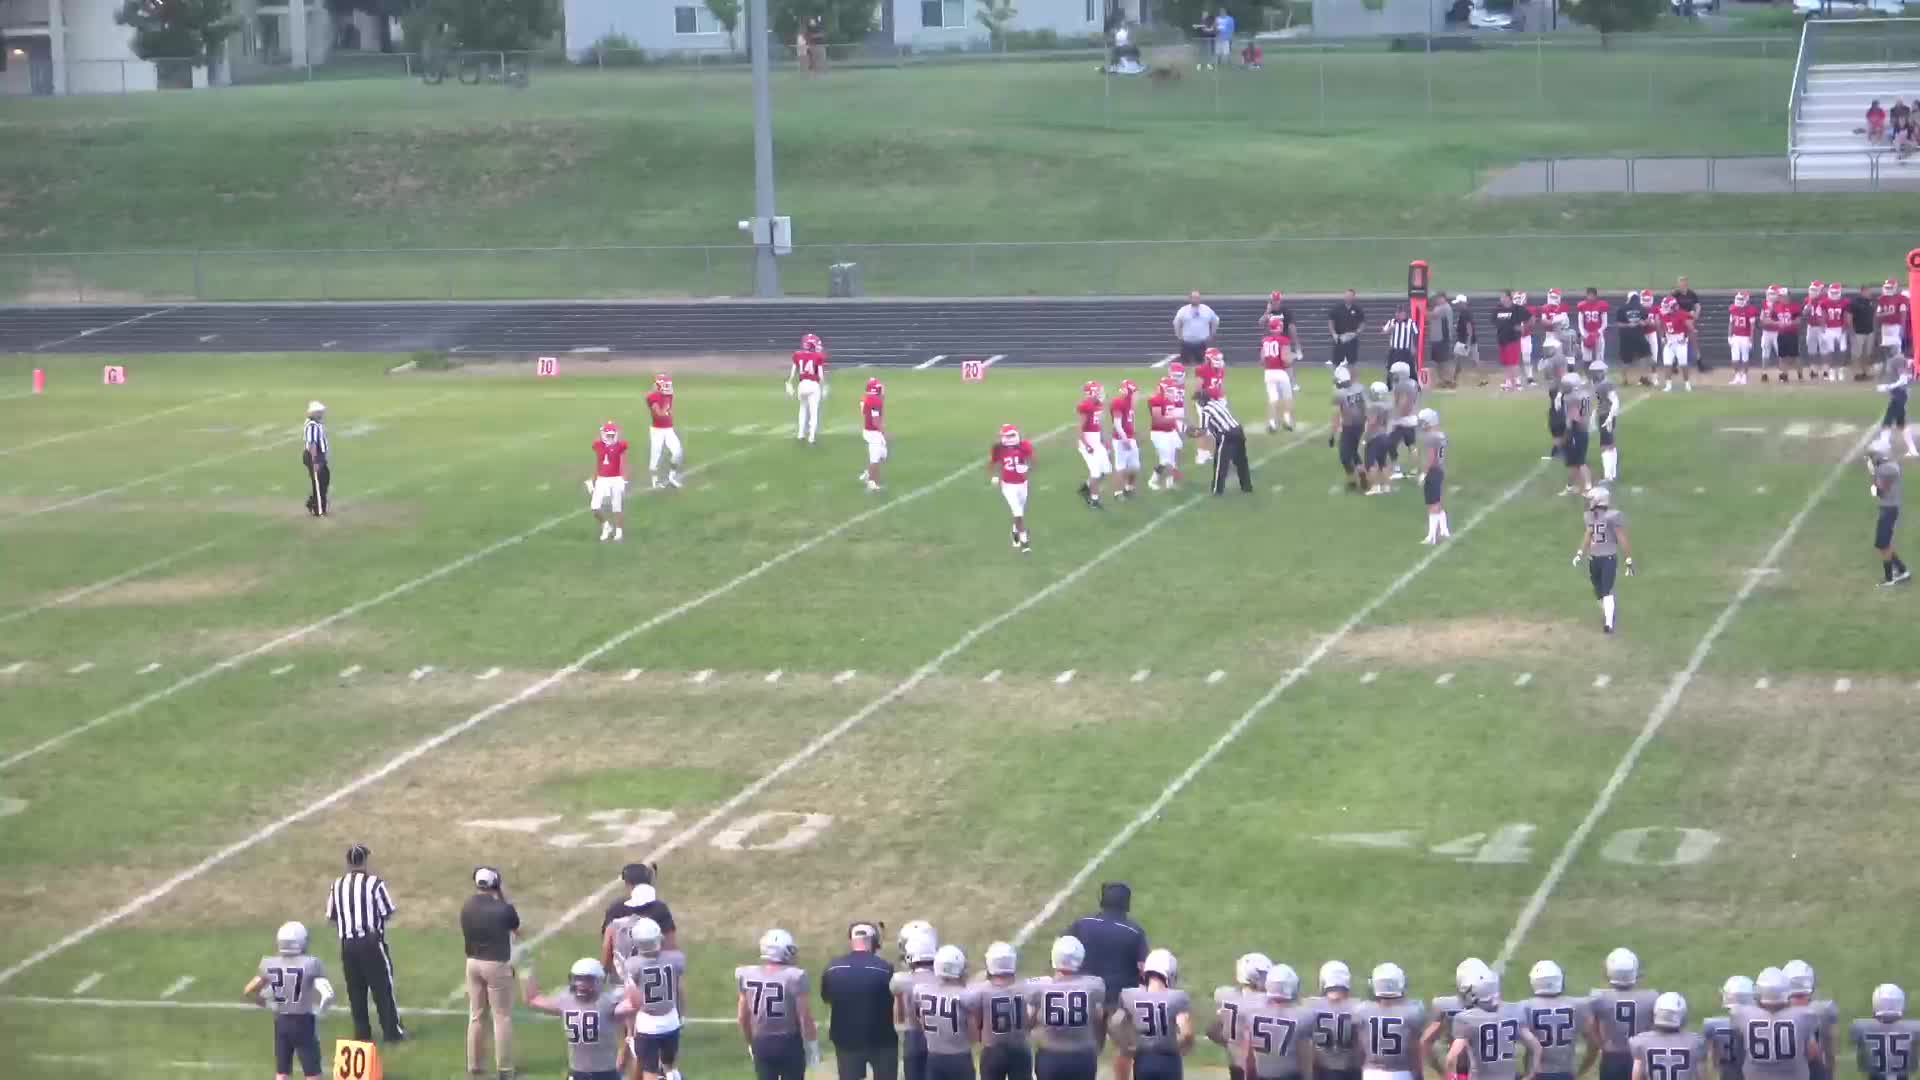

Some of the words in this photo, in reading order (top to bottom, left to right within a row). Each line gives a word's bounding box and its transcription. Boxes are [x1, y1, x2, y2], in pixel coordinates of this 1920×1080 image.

[540, 359, 553, 374] 10
[799, 359, 815, 375] 14
[965, 363, 979, 378] 20
[266, 966, 304, 1004] 27
[642, 965, 674, 1005] 21
[745, 980, 784, 1018] 72
[564, 1010, 600, 1044] 58
[918, 994, 960, 1034] 24
[990, 995, 1025, 1034] 61
[1044, 991, 1089, 1028] 68
[1134, 1001, 1169, 1036] 31
[1531, 1007, 1576, 1047] 52
[1615, 1000, 1637, 1039] 9
[1251, 1014, 1298, 1057] 57
[1314, 1012, 1353, 1050] 50
[1367, 1015, 1404, 1056] 15
[1749, 1019, 1796, 1061] 60
[339, 1046, 366, 1080] 30
[1646, 1046, 1691, 1080] 62
[1863, 1031, 1911, 1073] 35
